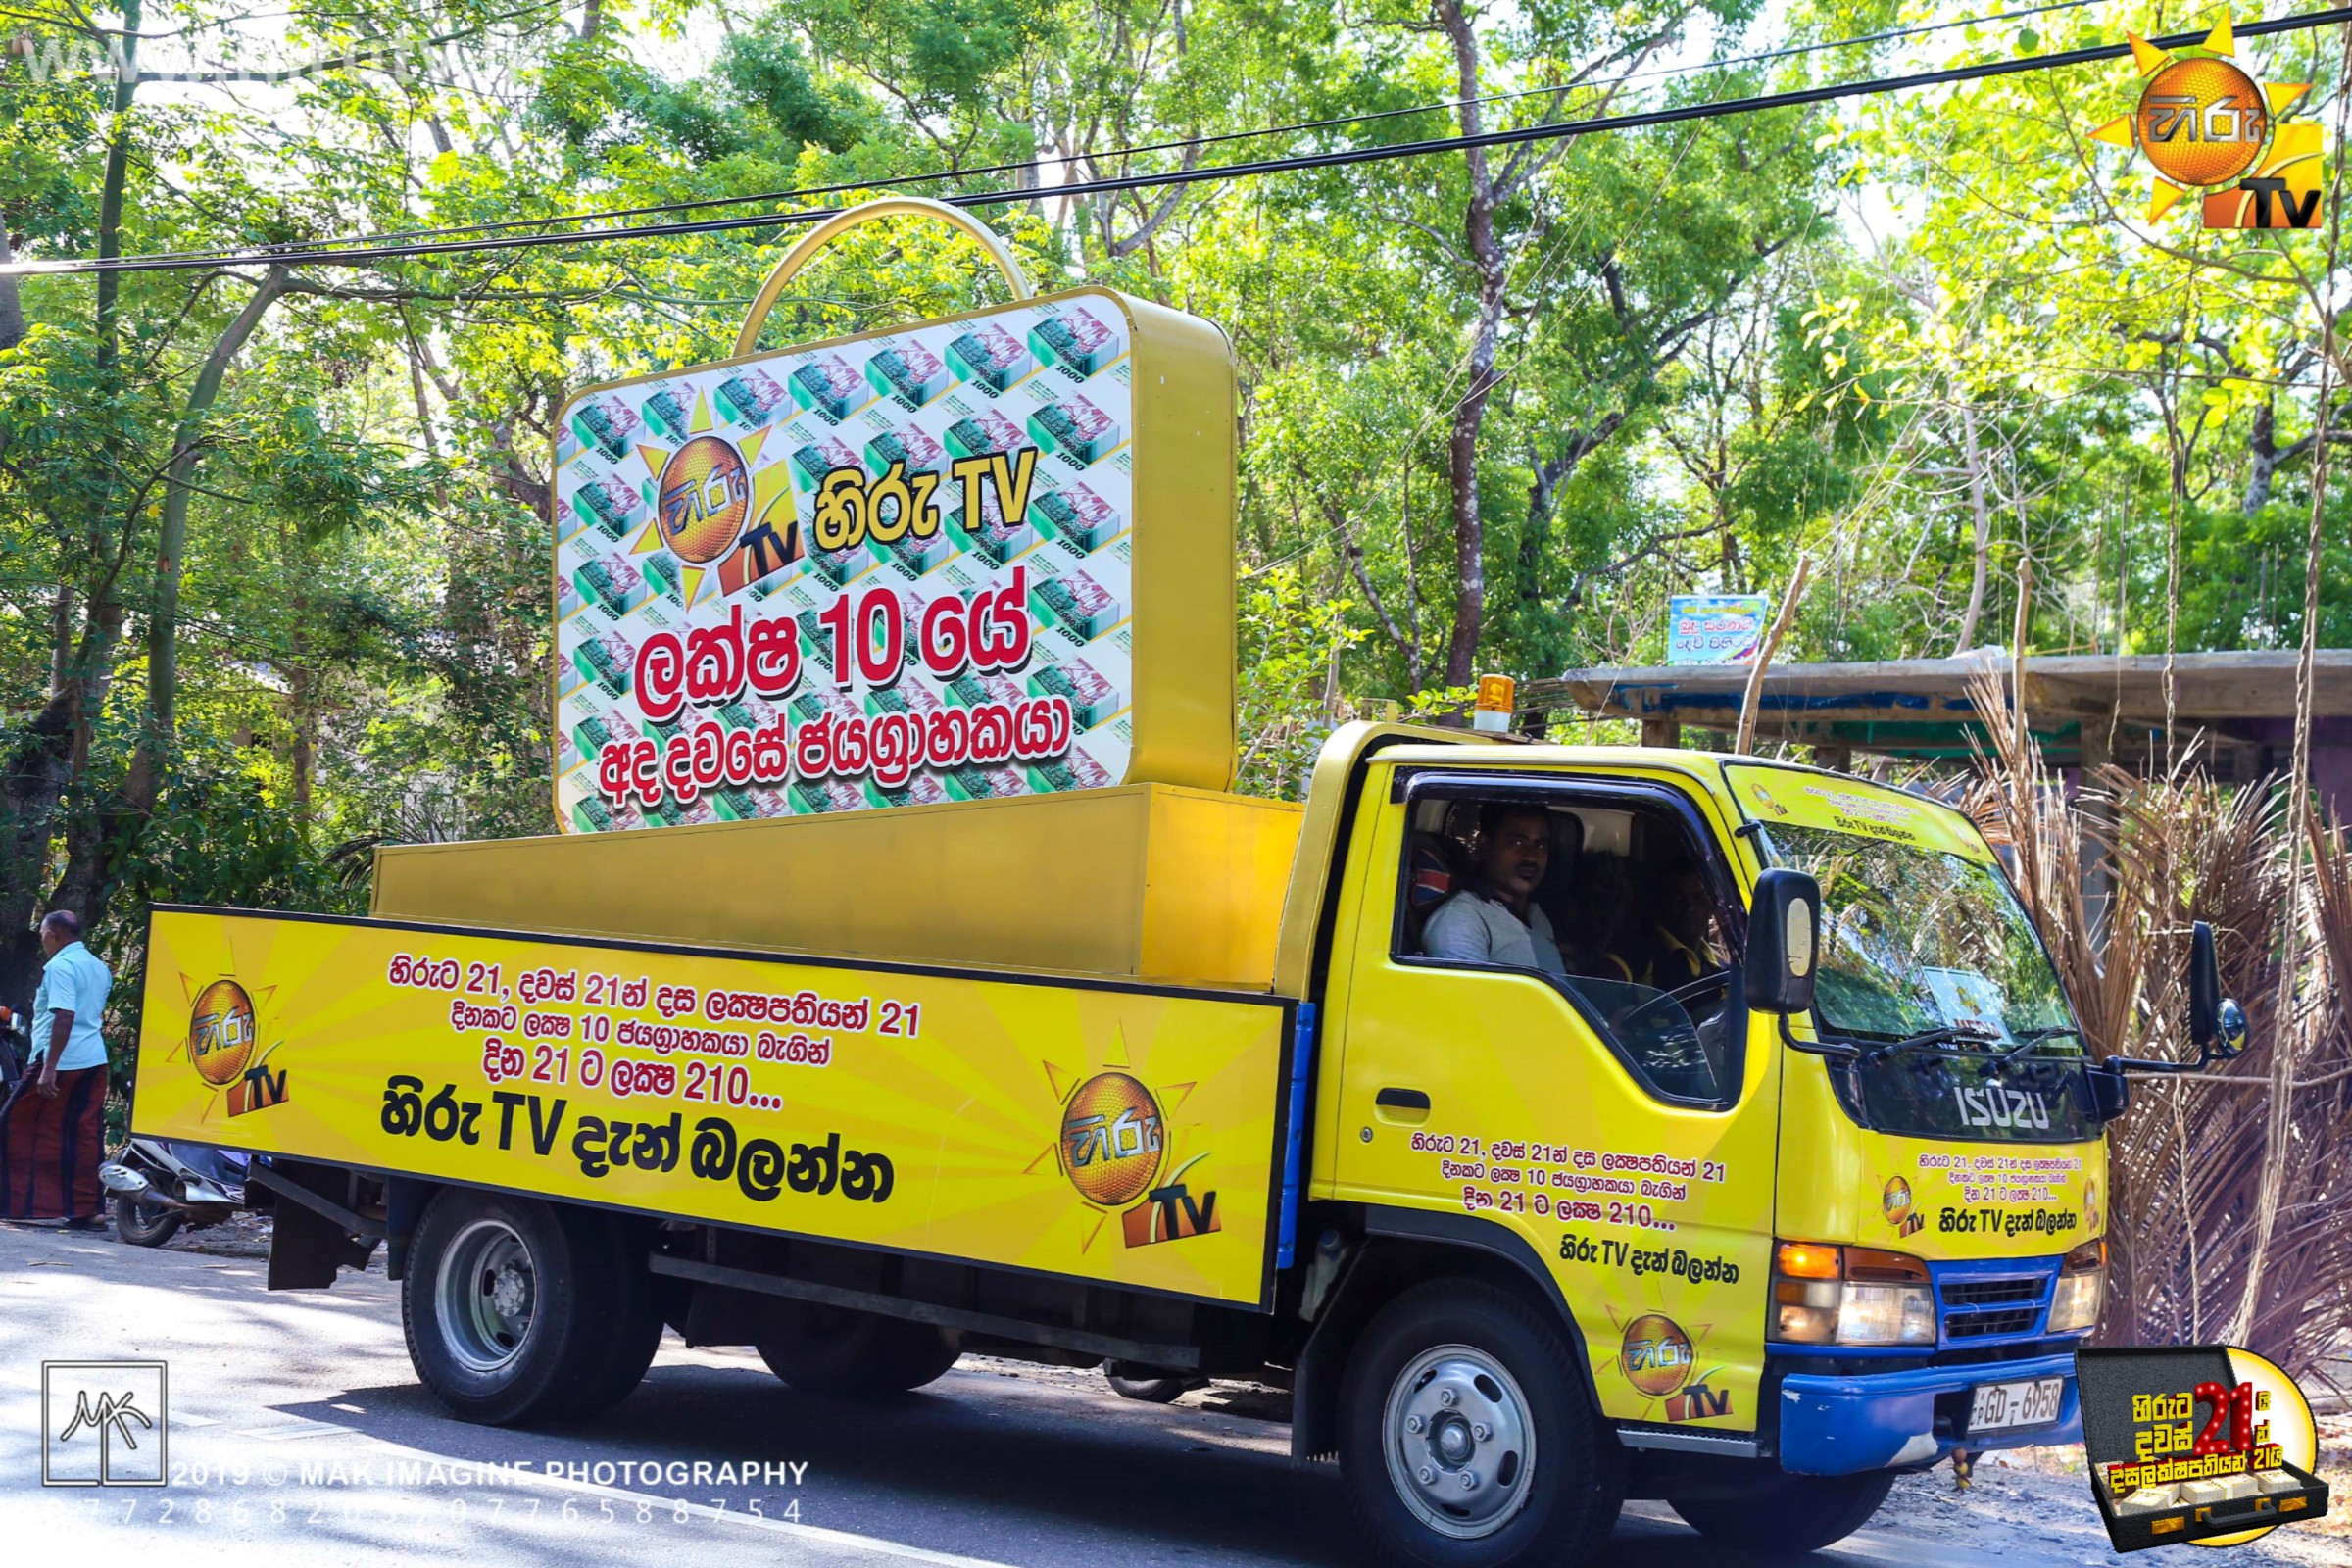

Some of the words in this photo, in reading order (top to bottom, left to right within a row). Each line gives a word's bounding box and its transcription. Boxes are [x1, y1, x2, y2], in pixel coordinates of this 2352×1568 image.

[814, 460, 940, 551] හිරු
[954, 448, 1038, 532] TV
[634, 604, 800, 719] ලක්ෂ
[819, 587, 902, 684] 10
[920, 565, 1030, 672] යේ
[600, 740, 662, 805] අද
[665, 712, 787, 800] දවසේ
[389, 955, 460, 989] හිරුට
[466, 963, 510, 1000] 21,
[518, 969, 576, 1004] දවස්
[584, 974, 648, 1008] 21න්
[656, 986, 696, 1017] දස
[879, 1002, 919, 1036] 21
[451, 1001, 517, 1030] දිනකට
[581, 1015, 610, 1041] 10
[758, 1033, 831, 1065] බැගින්
[483, 1038, 524, 1082] දින
[532, 1045, 568, 1083] 21
[580, 1050, 603, 1087] ට
[683, 1061, 782, 1109] 210...
[1953, 1086, 2049, 1129] ISUZU
[380, 1075, 483, 1145] හිරු
[492, 1091, 568, 1156] TV
[571, 1112, 682, 1178] දැන්
[690, 1117, 895, 1203] බලන්න
[1411, 1132, 1455, 1153] හිරුට
[1459, 1137, 1486, 1159] 21,
[1491, 1141, 1526, 1160] දවස්
[1531, 1144, 1568, 1163] 21න්
[1572, 1151, 1596, 1168] දස
[1702, 1162, 1726, 1182] 21
[1442, 1160, 1485, 1179] දිනකට
[1527, 1169, 1546, 1185] 10
[1641, 1180, 1686, 1200] බැගින්
[1463, 1186, 1494, 1211] දින
[1499, 1191, 1525, 1212] 21
[1534, 1194, 1550, 1215] ට
[1609, 1201, 1676, 1231] 210...
[1983, 1186, 1995, 1200] 21
[1979, 1209, 2003, 1232] TV
[1559, 1234, 1598, 1263] හිරු
[1601, 1240, 1629, 1267] TV
[1630, 1248, 1669, 1275] දැන්
[1671, 1250, 1740, 1284] බලන්න
